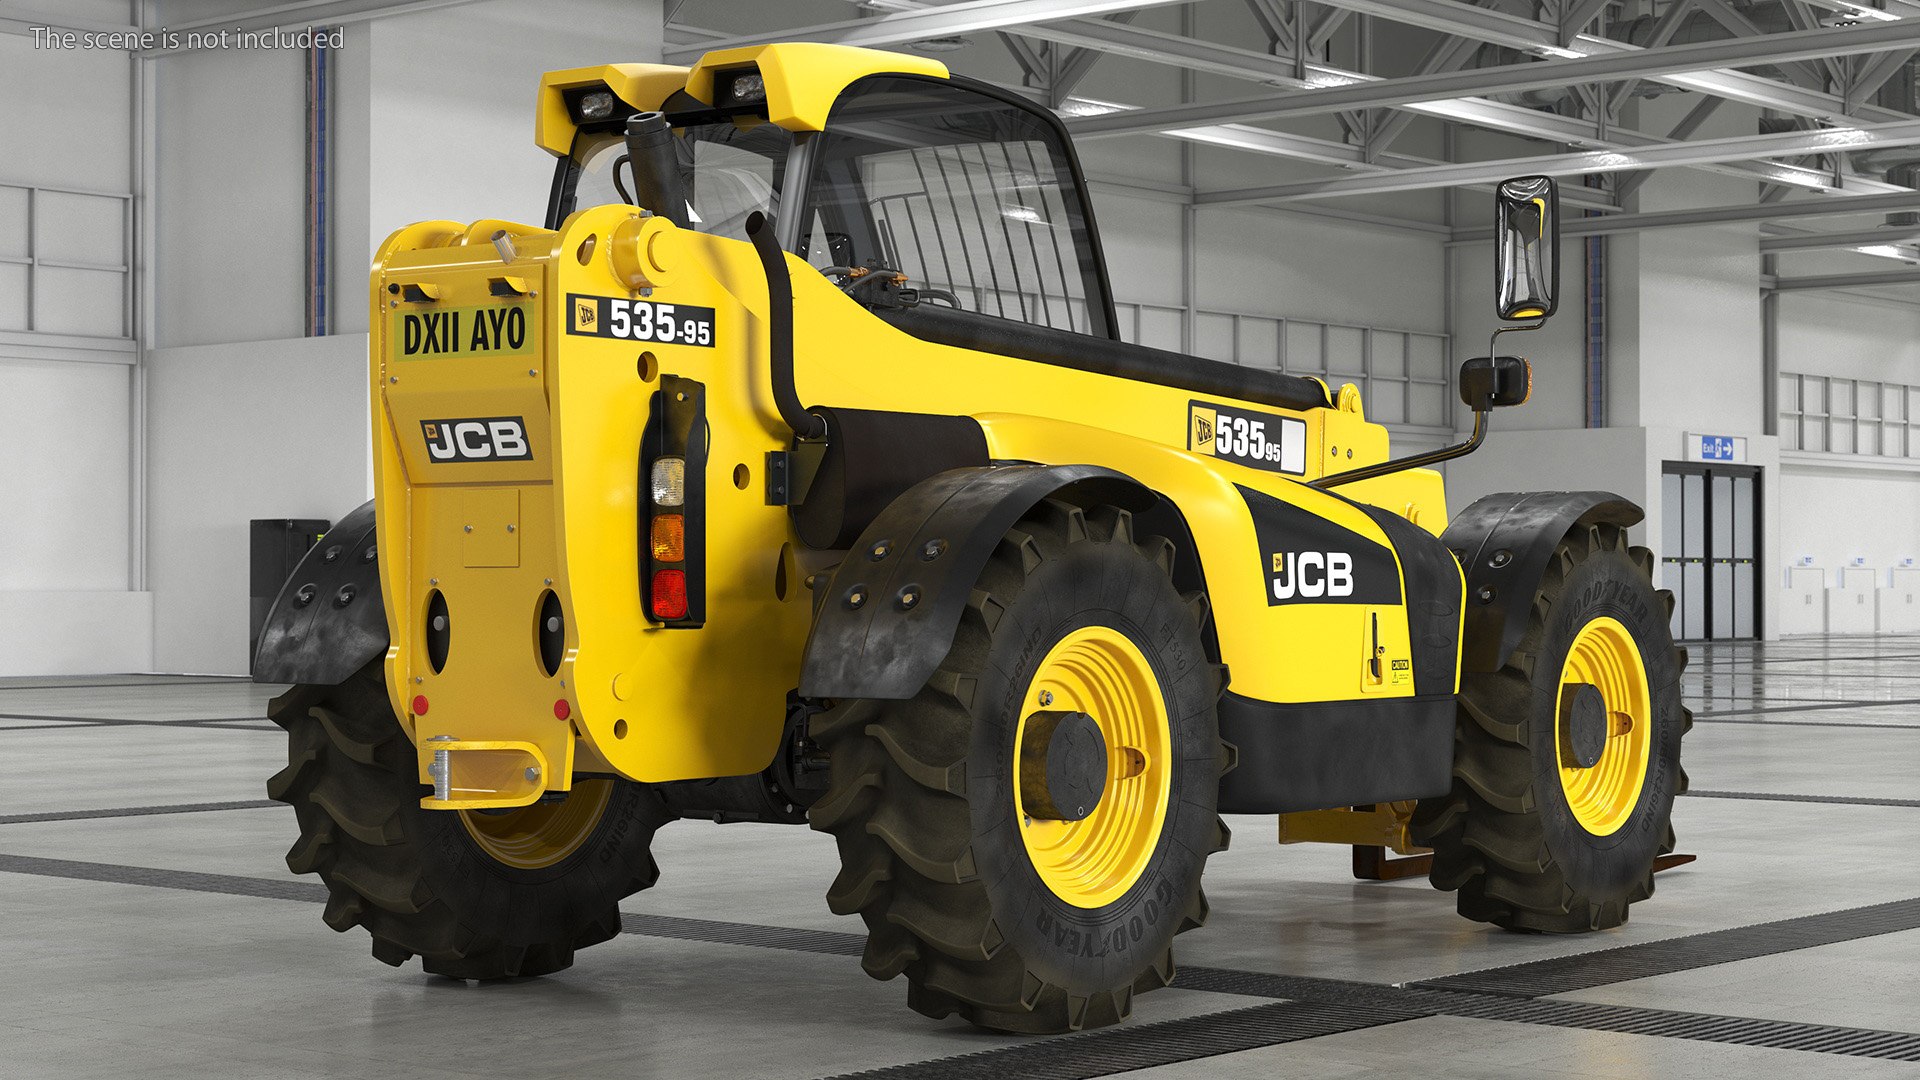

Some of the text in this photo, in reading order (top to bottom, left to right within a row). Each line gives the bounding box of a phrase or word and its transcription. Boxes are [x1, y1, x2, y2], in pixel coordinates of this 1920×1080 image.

[580, 306, 596, 324] JCB
[610, 299, 711, 345] 535-95
[429, 421, 527, 459] JCB
[1197, 419, 1212, 442] JCB
[1273, 551, 1354, 599] JCB
[1565, 579, 1648, 630] GOODYEAR
[1036, 878, 1174, 958] GOODYEAR
